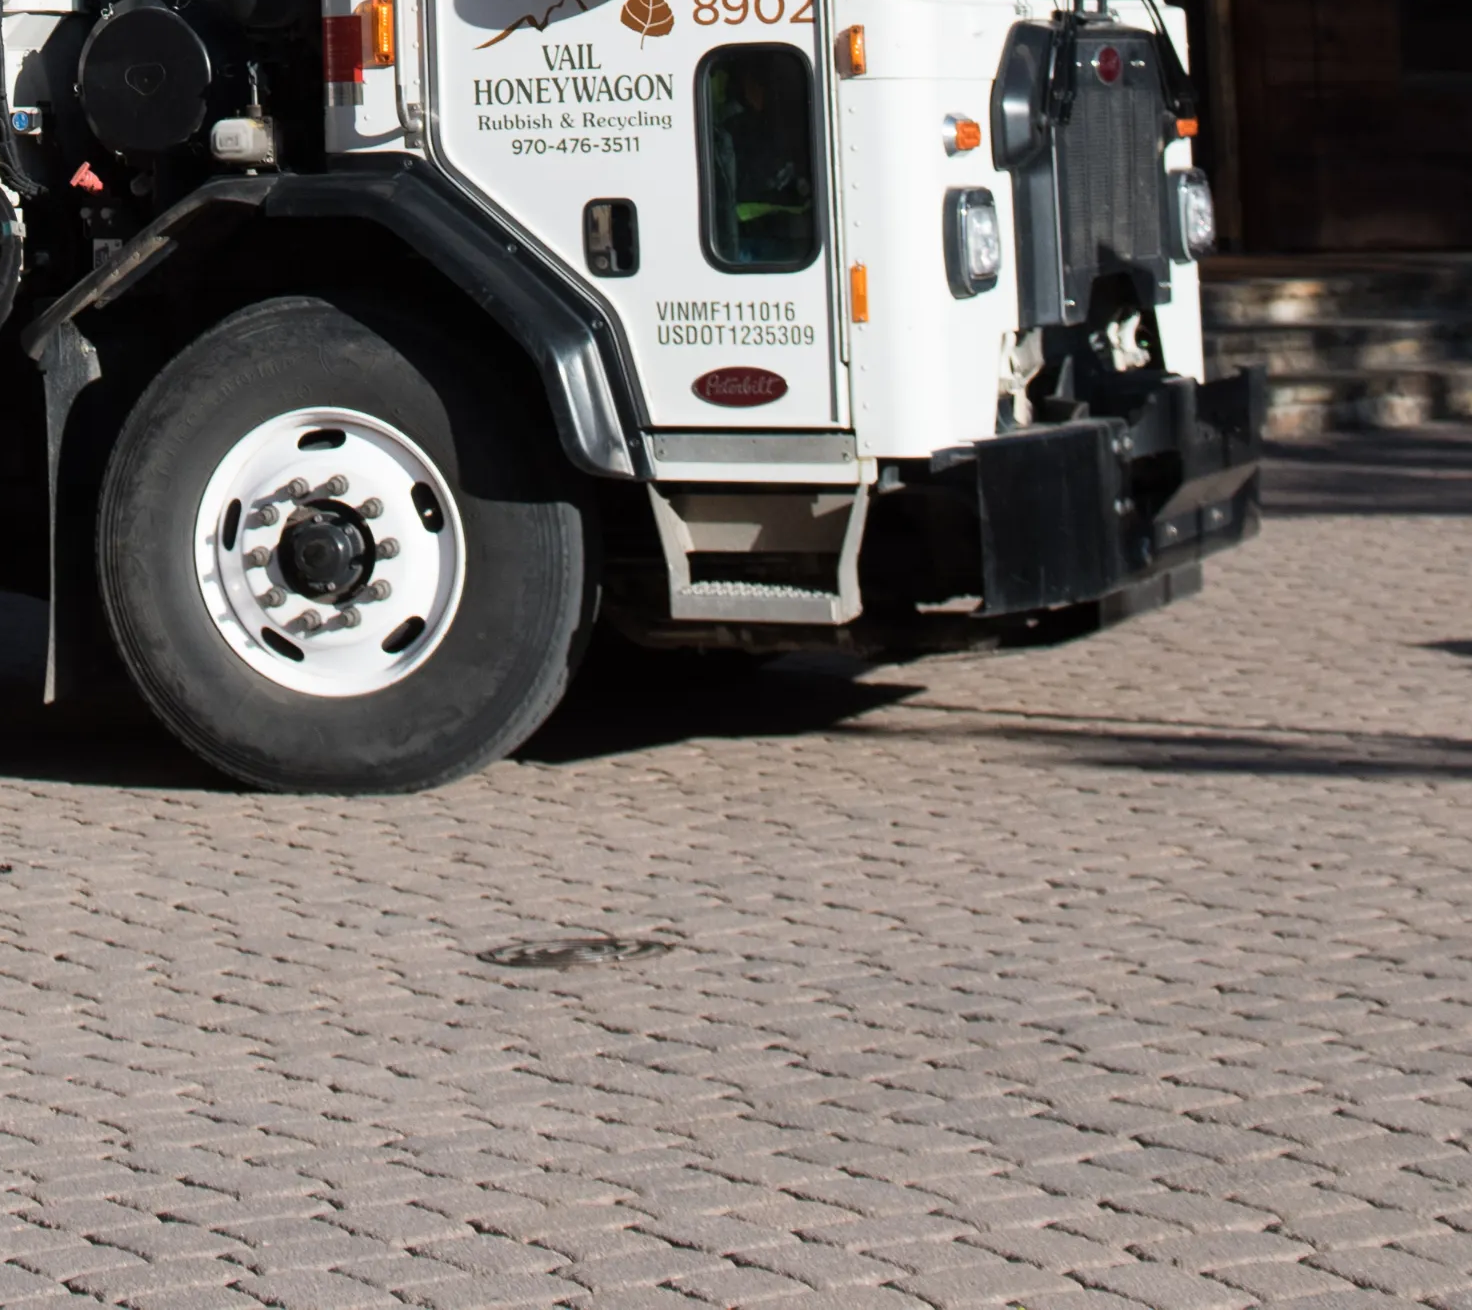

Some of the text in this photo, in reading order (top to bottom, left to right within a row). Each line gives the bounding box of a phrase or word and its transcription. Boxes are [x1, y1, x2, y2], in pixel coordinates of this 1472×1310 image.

[542, 43, 602, 71] VAIL
[473, 73, 673, 105] HONEYWAGON
[478, 110, 673, 131] Rubbish & Recycling
[511, 136, 640, 155] 970-476-3511
